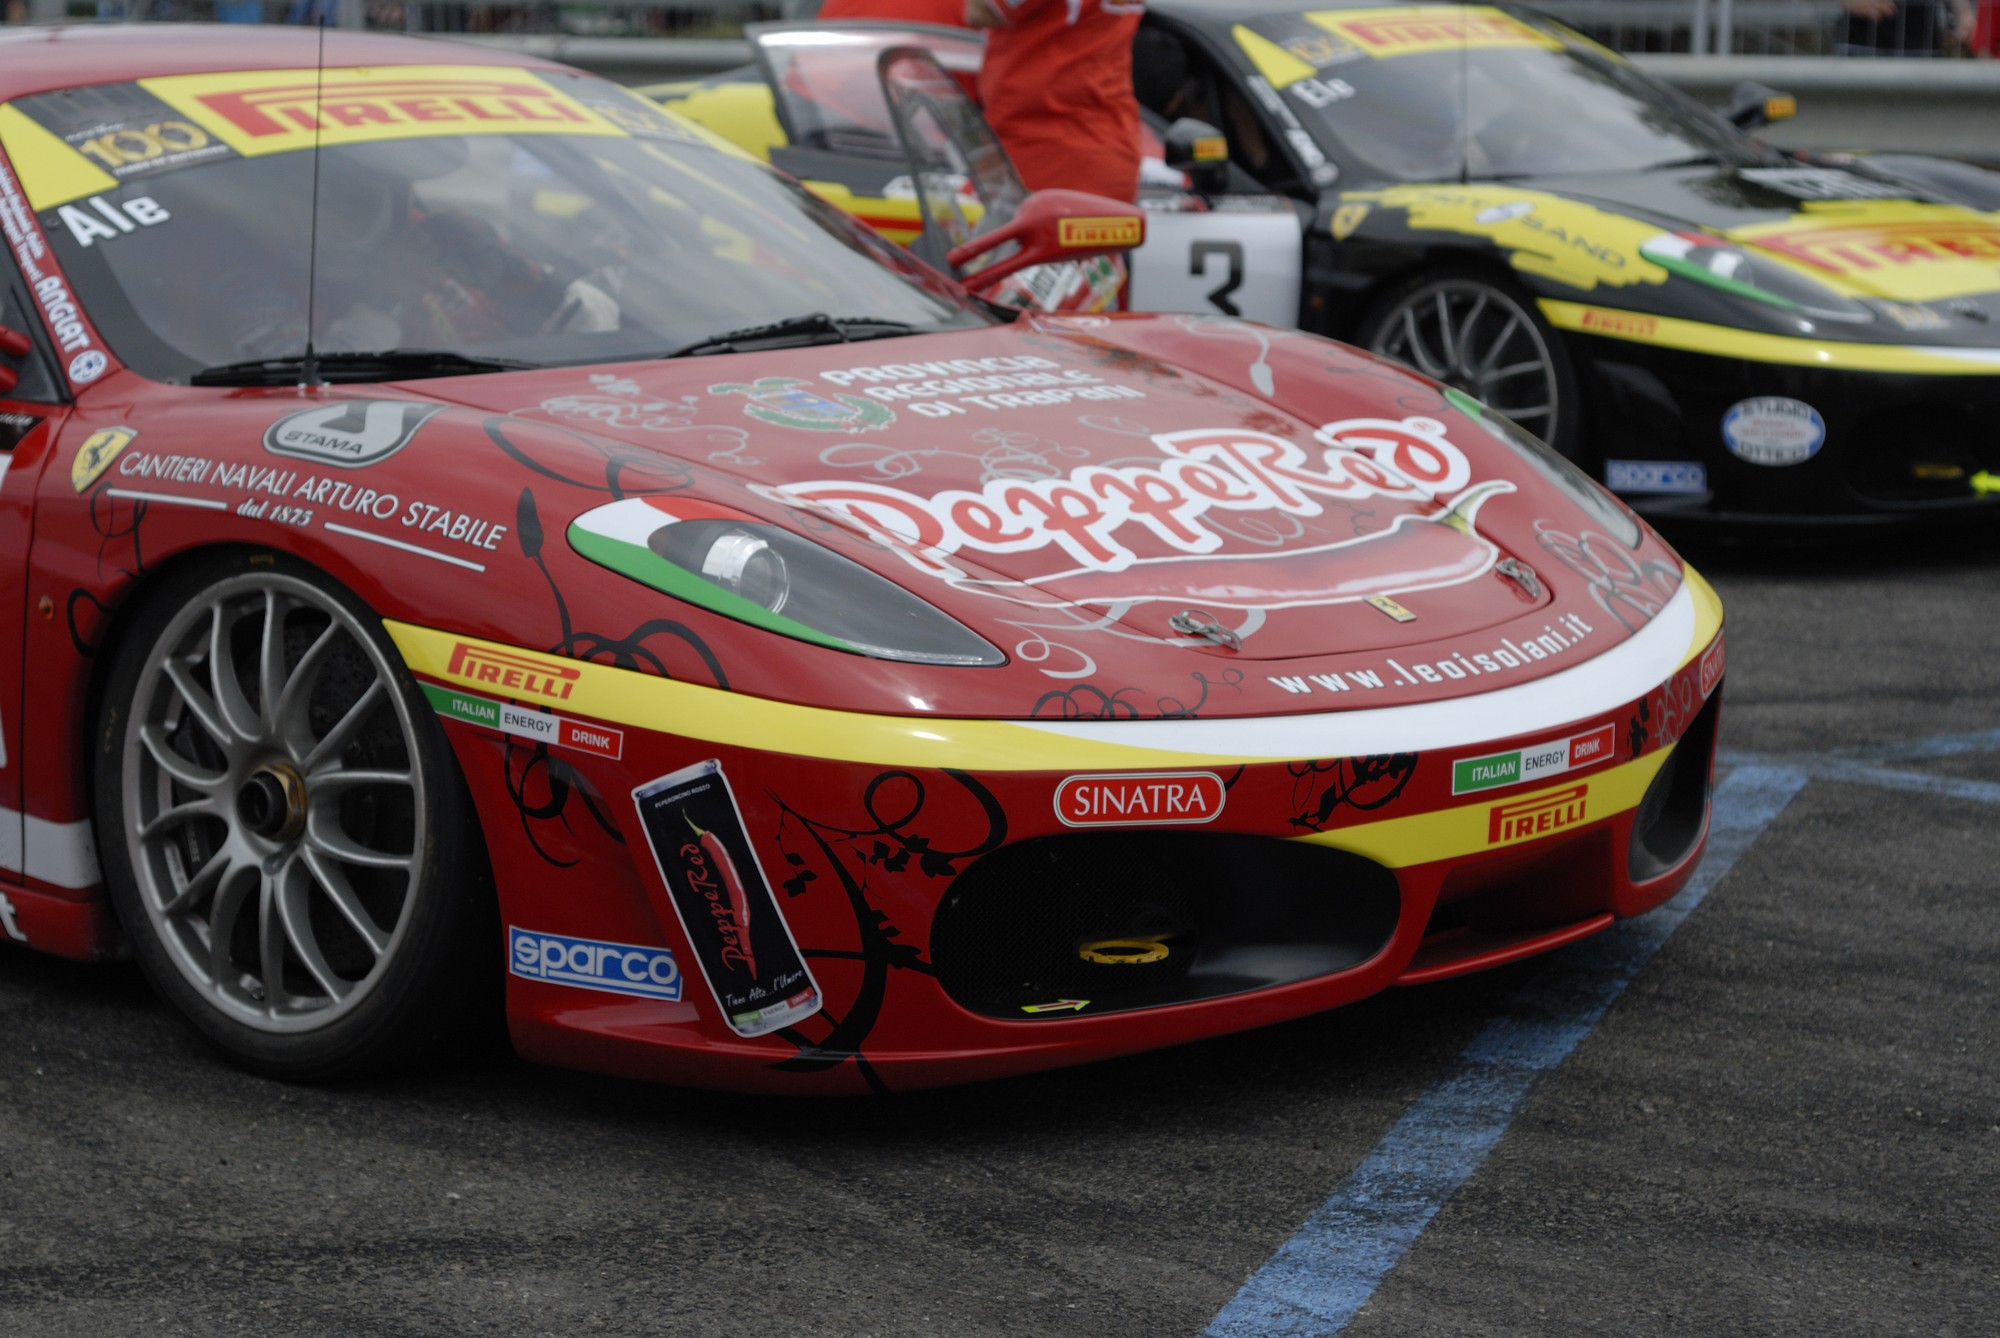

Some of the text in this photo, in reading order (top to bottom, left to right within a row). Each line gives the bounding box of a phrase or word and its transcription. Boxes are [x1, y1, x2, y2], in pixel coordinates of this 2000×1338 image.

[192, 79, 594, 138] PIRELLI
[79, 121, 208, 168] 100
[58, 196, 171, 247] Ale
[1065, 221, 1137, 242] PIRELLI
[284, 430, 363, 454] STAMA
[119, 451, 508, 550] CANTIERI NAVALI ARTURO STABILE
[236, 498, 314, 527] dal 1875
[447, 642, 581, 701] PIRELLI
[452, 698, 611, 749] ITALIAN ENERGY DRINK
[1472, 738, 1600, 782] ITALIAN ENERGY DRINK
[1073, 783, 1208, 817] SINATRA
[1488, 783, 1588, 845] PIRELLI
[514, 935, 678, 985] sparco
